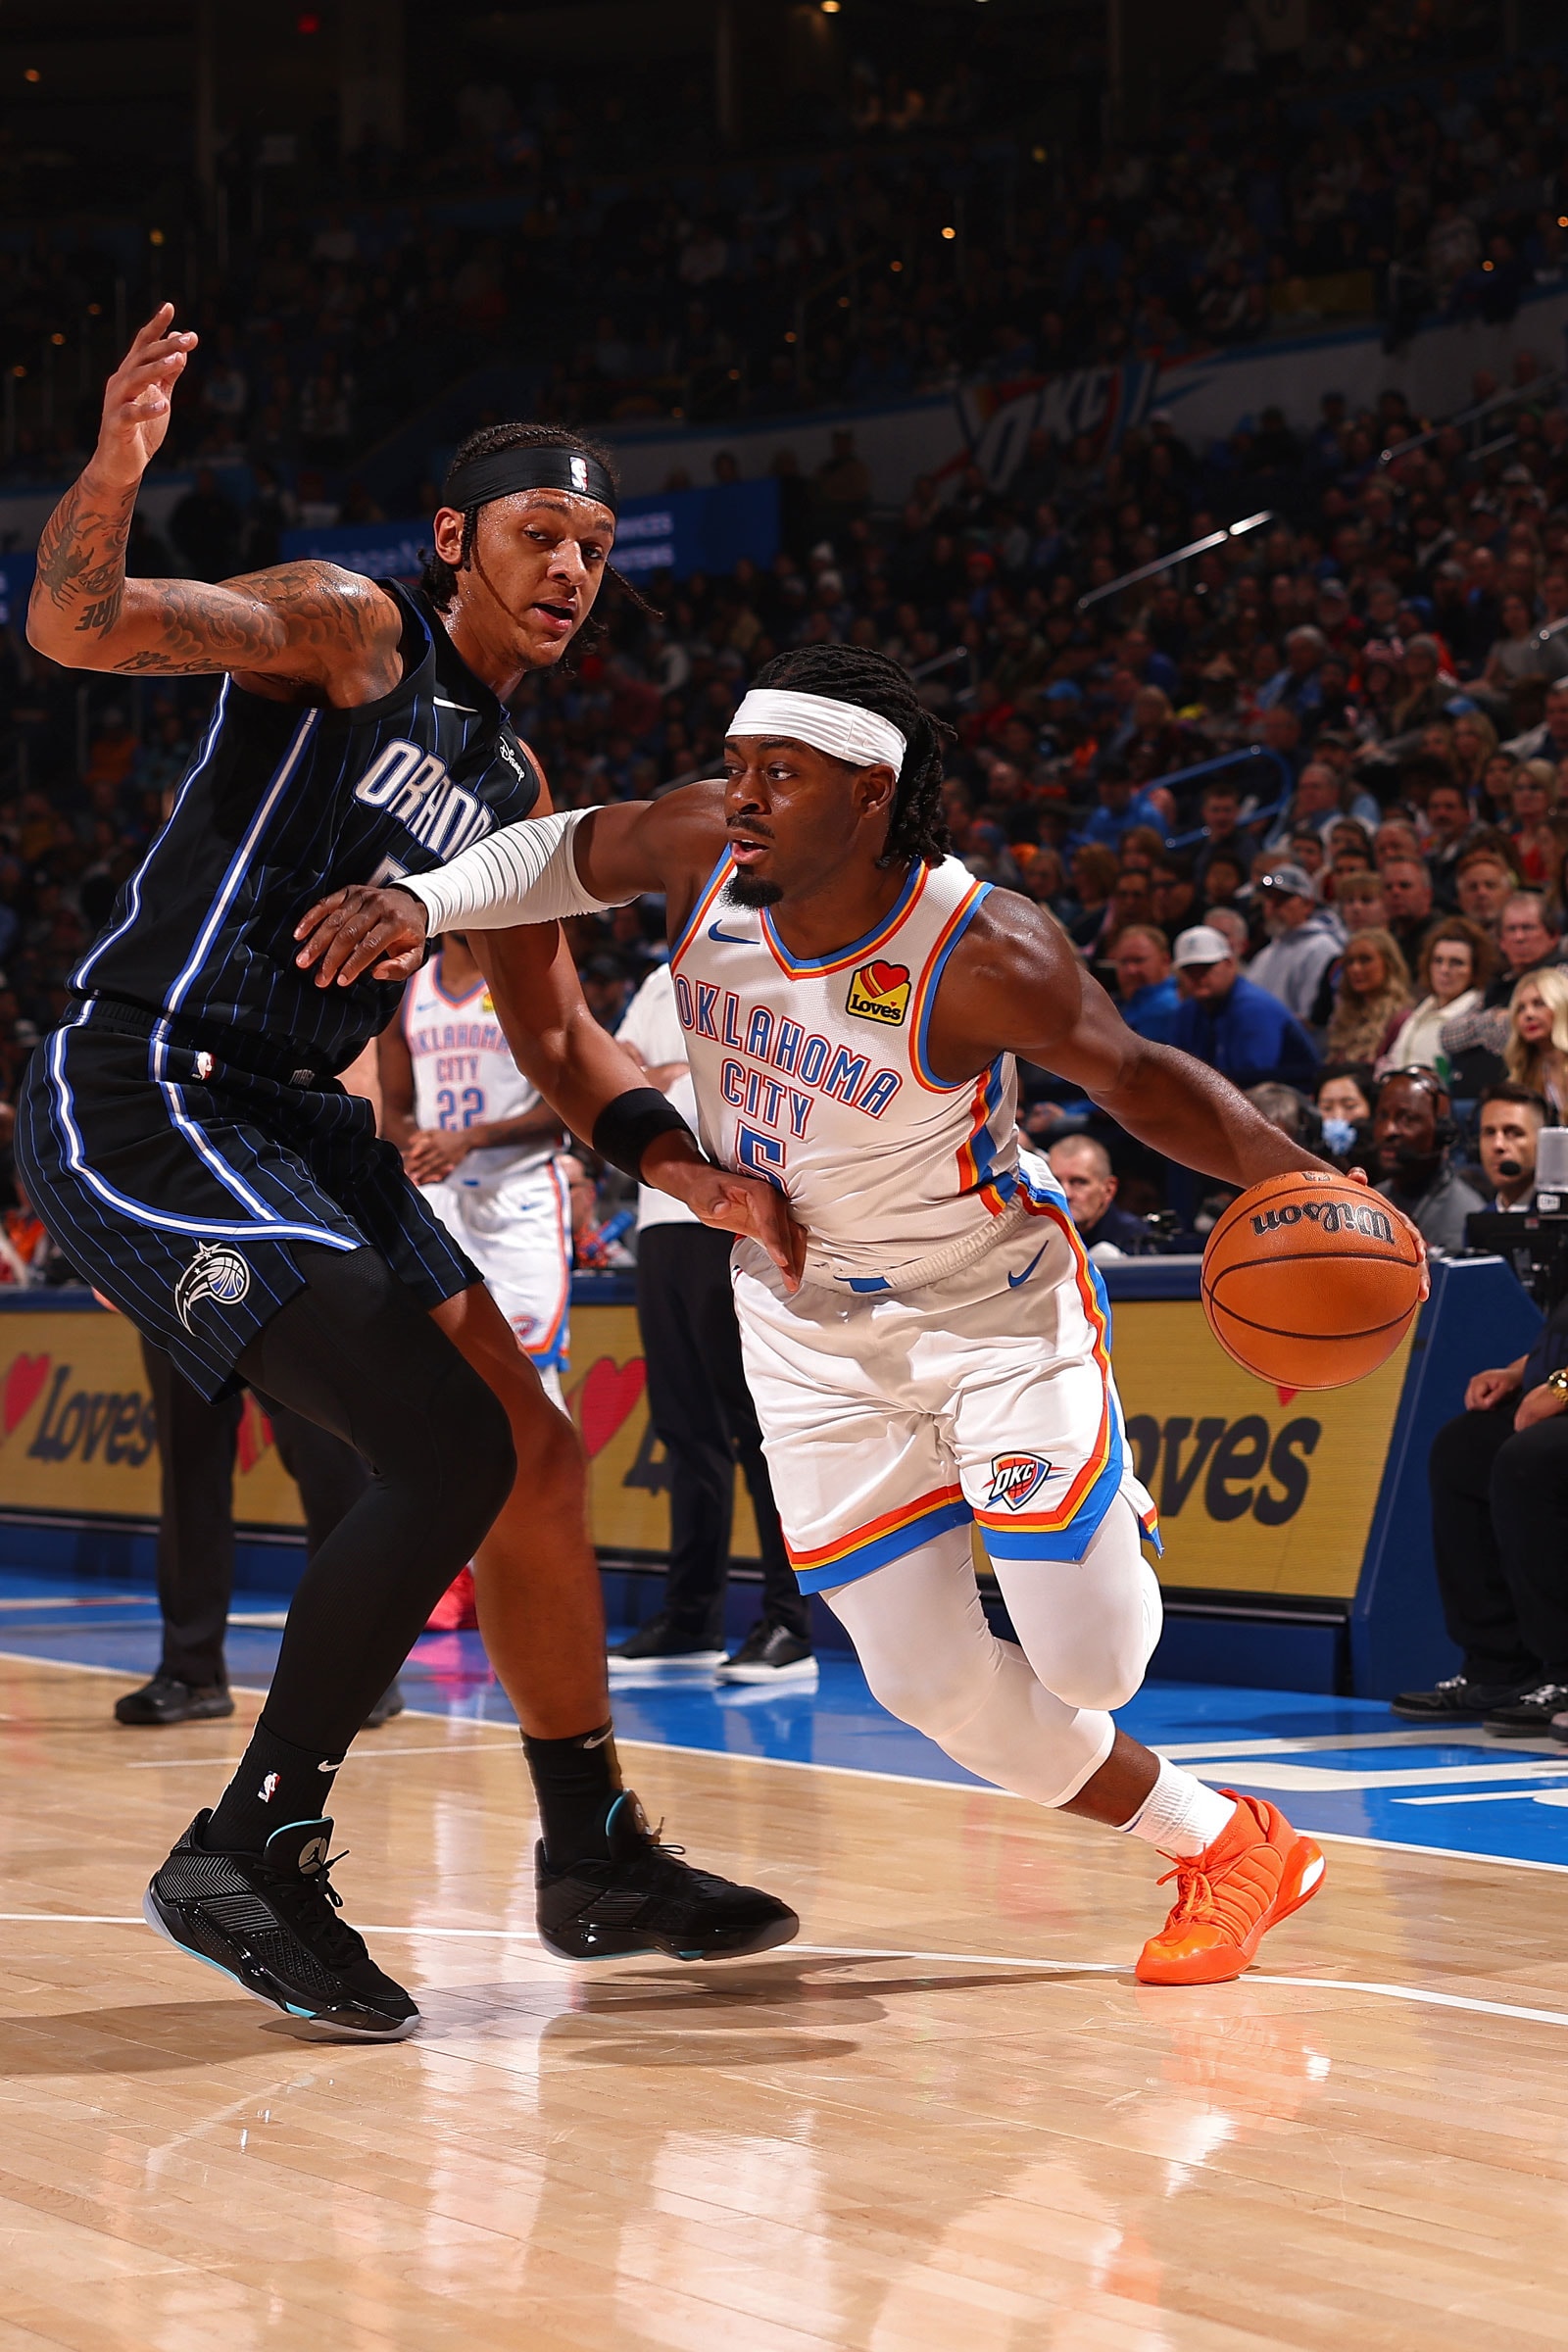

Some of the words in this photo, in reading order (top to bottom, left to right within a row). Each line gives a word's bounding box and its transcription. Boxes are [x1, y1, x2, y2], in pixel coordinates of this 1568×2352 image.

[436, 1054, 481, 1083] CITY
[674, 973, 904, 1120] OKLAHOMA
[437, 1087, 485, 1133] 22
[720, 1057, 815, 1140] CITY
[735, 1119, 788, 1197] 5
[1250, 1201, 1396, 1246] Wilson
[989, 1463, 1036, 1500] OKC
